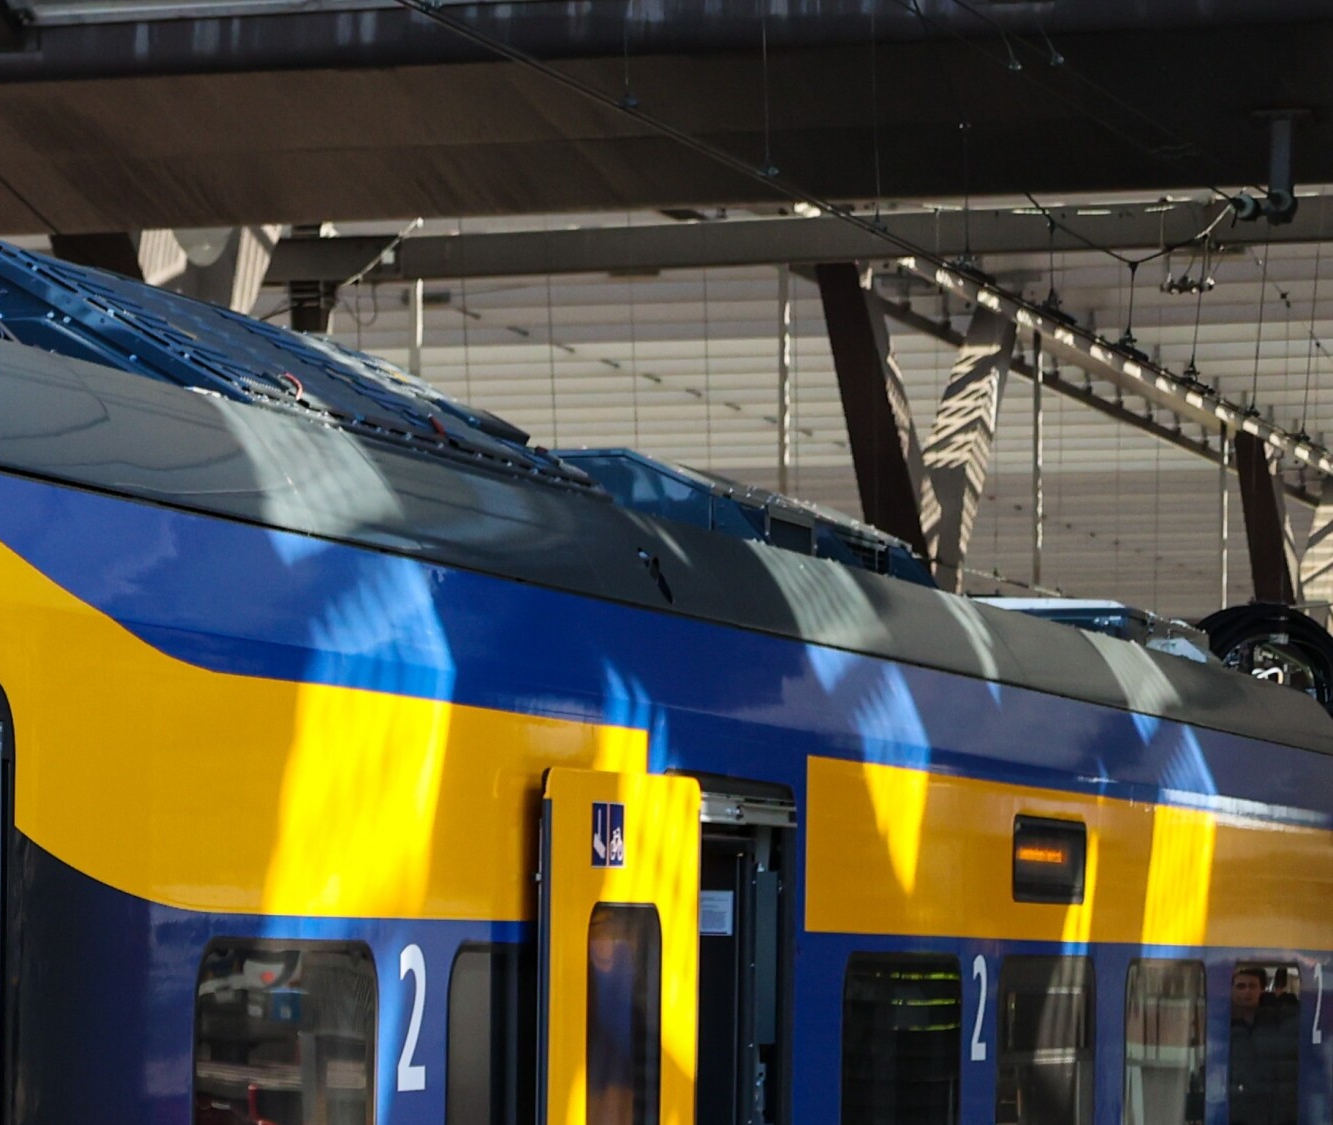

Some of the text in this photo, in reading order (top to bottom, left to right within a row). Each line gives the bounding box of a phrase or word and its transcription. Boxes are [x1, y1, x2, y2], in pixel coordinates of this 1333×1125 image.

[397, 943, 426, 1092] 2
[971, 954, 987, 1061] 2
[1312, 963, 1322, 1044] 2
